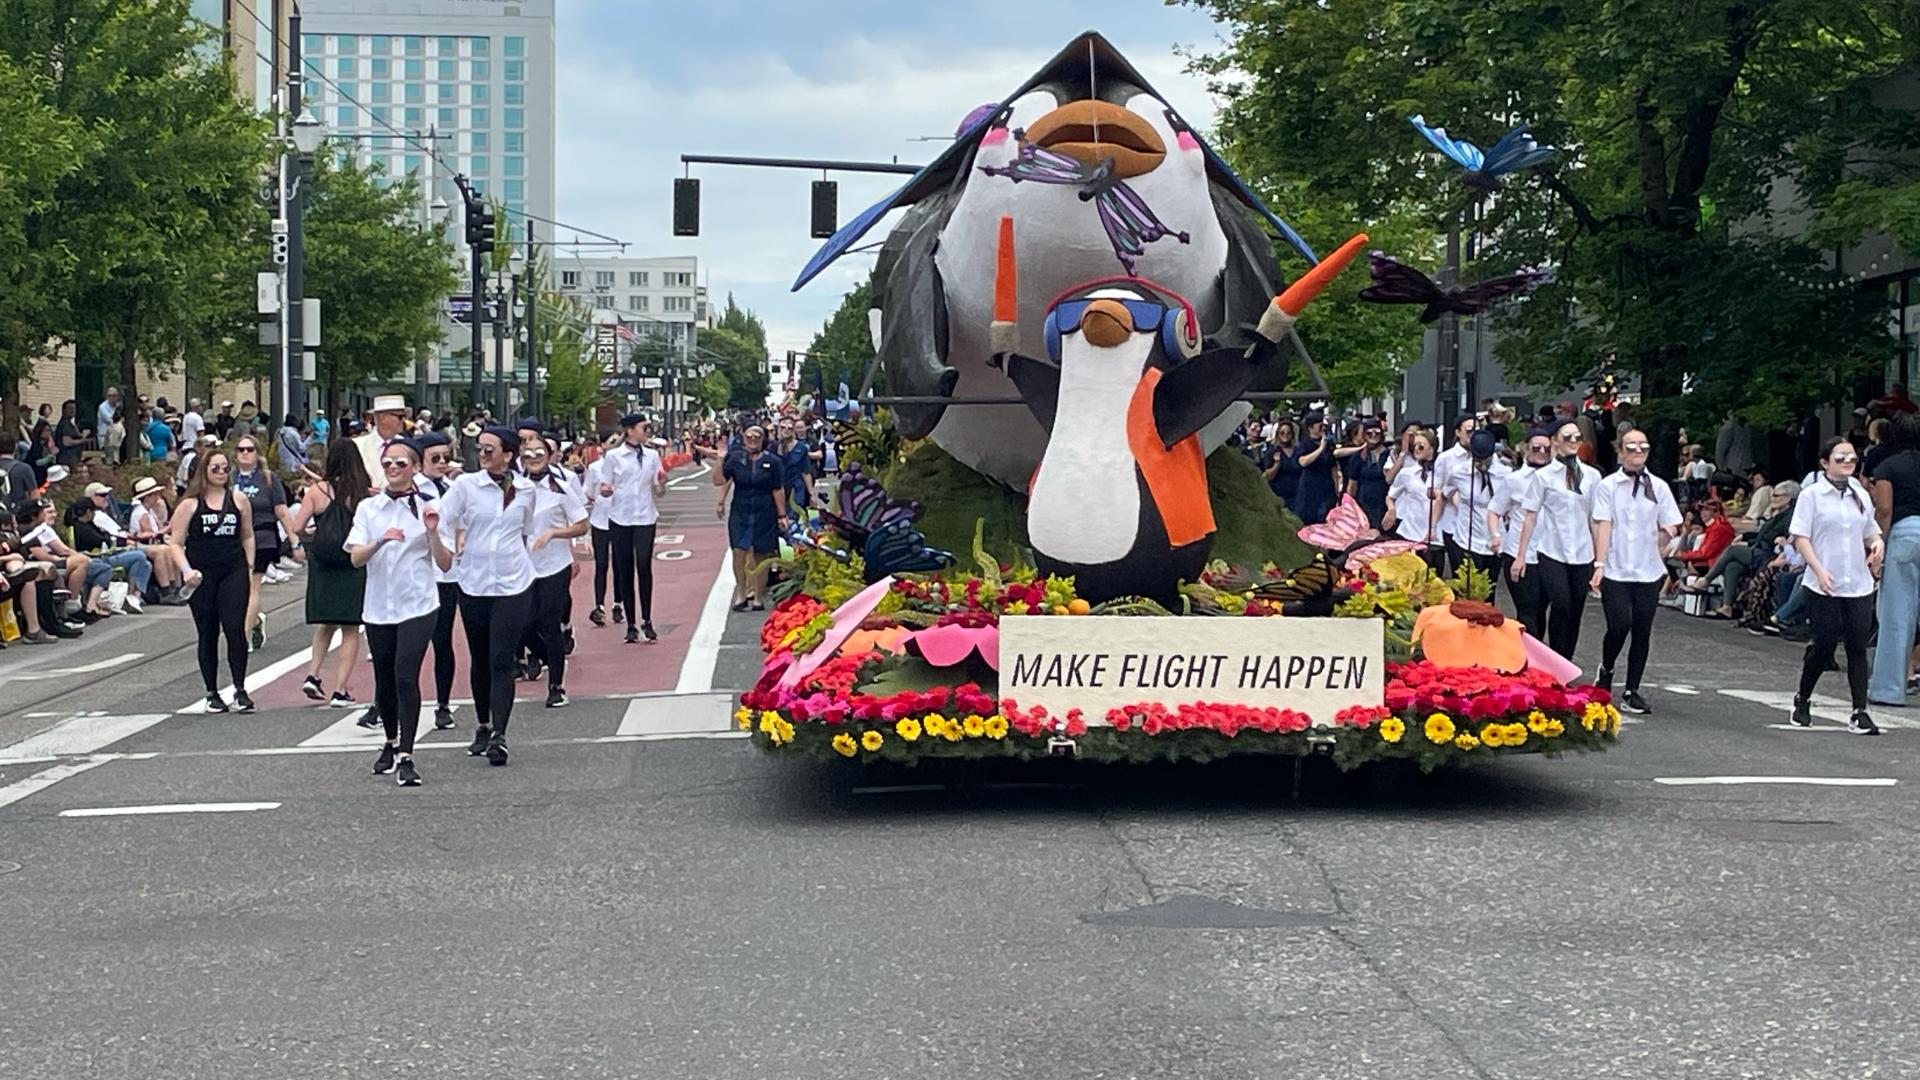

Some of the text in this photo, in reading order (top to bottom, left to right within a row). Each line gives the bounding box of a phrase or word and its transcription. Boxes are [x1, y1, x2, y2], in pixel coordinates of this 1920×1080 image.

[1011, 653, 1367, 689] MAKE FLIGHT HAPPEN
